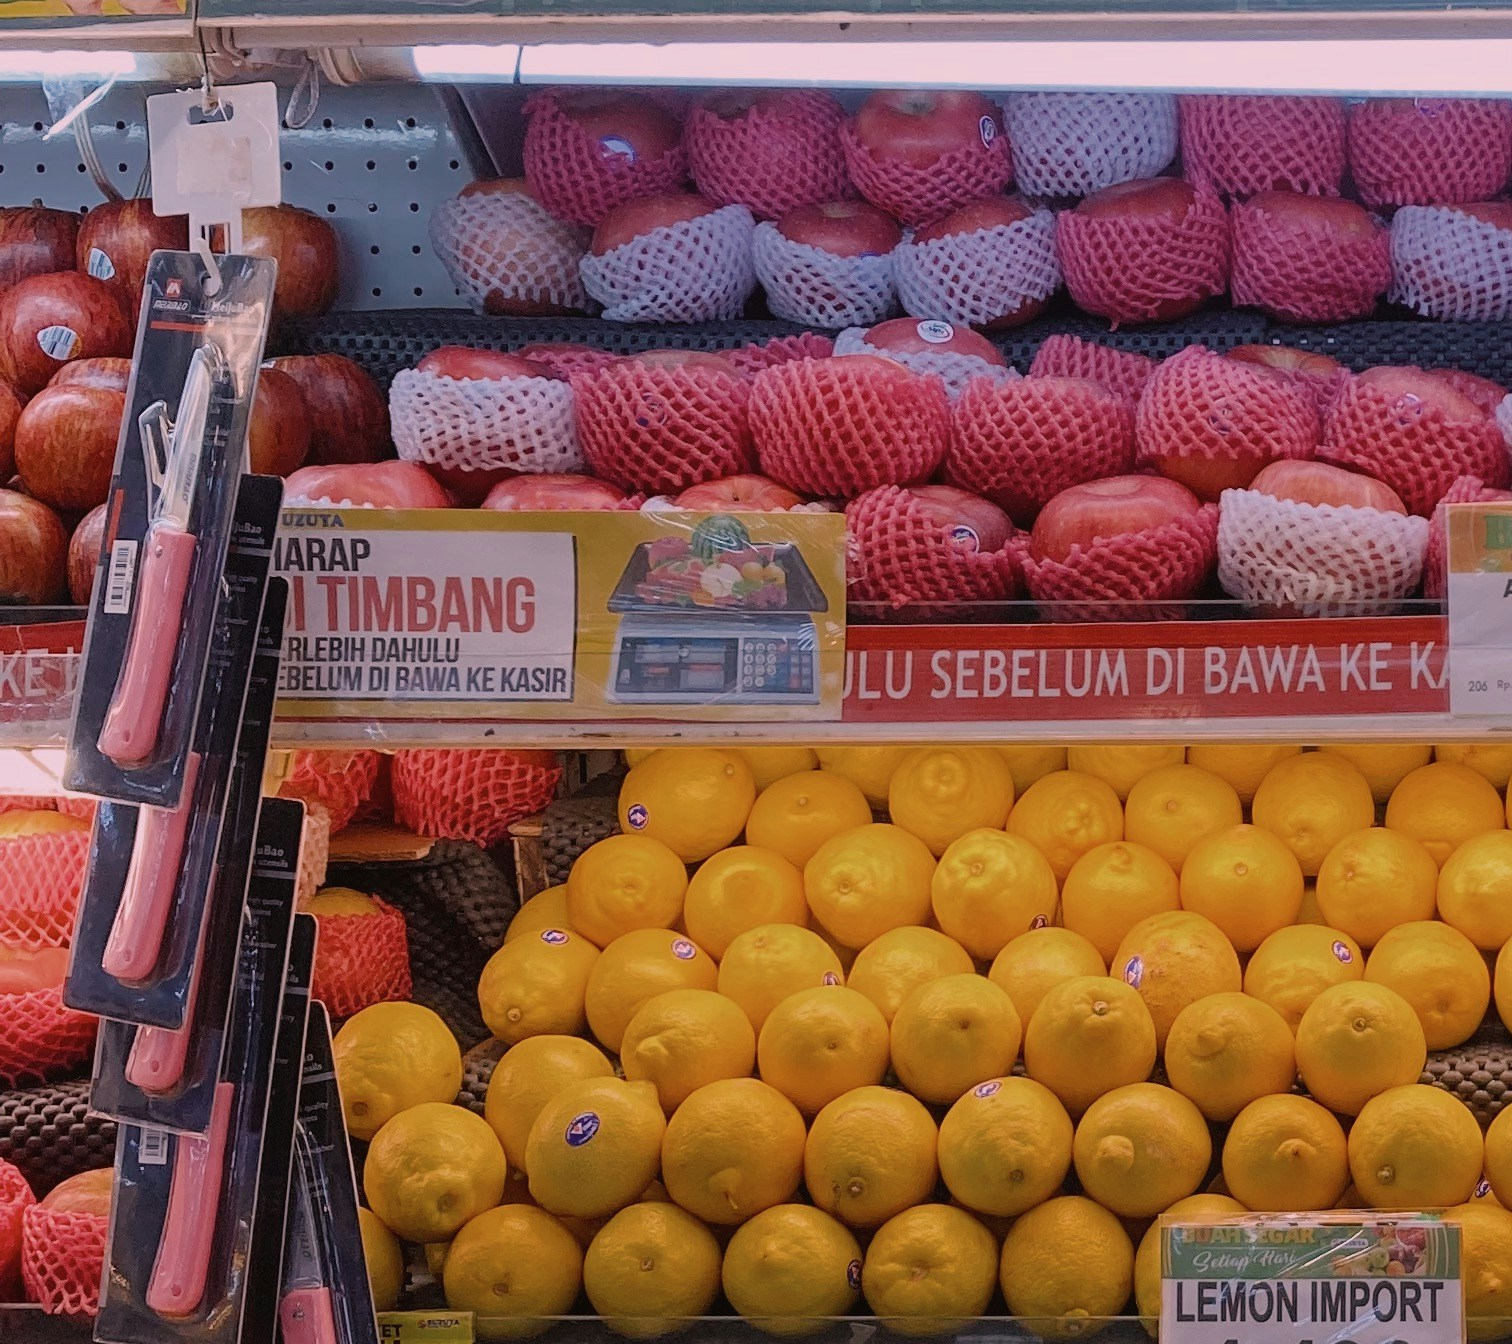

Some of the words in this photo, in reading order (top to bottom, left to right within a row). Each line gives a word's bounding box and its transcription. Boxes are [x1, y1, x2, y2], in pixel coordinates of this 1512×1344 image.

[282, 513, 344, 528] UZUTA
[286, 576, 305, 632] I
[325, 576, 535, 634] TIMBANG
[283, 637, 369, 664] RLEBIH
[372, 637, 460, 664] DAHULU
[278, 666, 362, 693] BELUM
[368, 666, 392, 692] DI
[397, 666, 461, 693] BAWA
[466, 666, 496, 692] KE
[501, 666, 567, 693] KASIR
[930, 648, 1129, 699] SEBELUM
[1147, 646, 1185, 696] DI
[1204, 643, 1326, 695] BAWA
[1339, 642, 1393, 692] KE
[1468, 680, 1488, 692] 206
[1193, 1251, 1250, 1273] Setiap
[1254, 1249, 1299, 1267] Hari
[1176, 1280, 1299, 1324] LEMON
[1310, 1281, 1444, 1324] IMPORT
